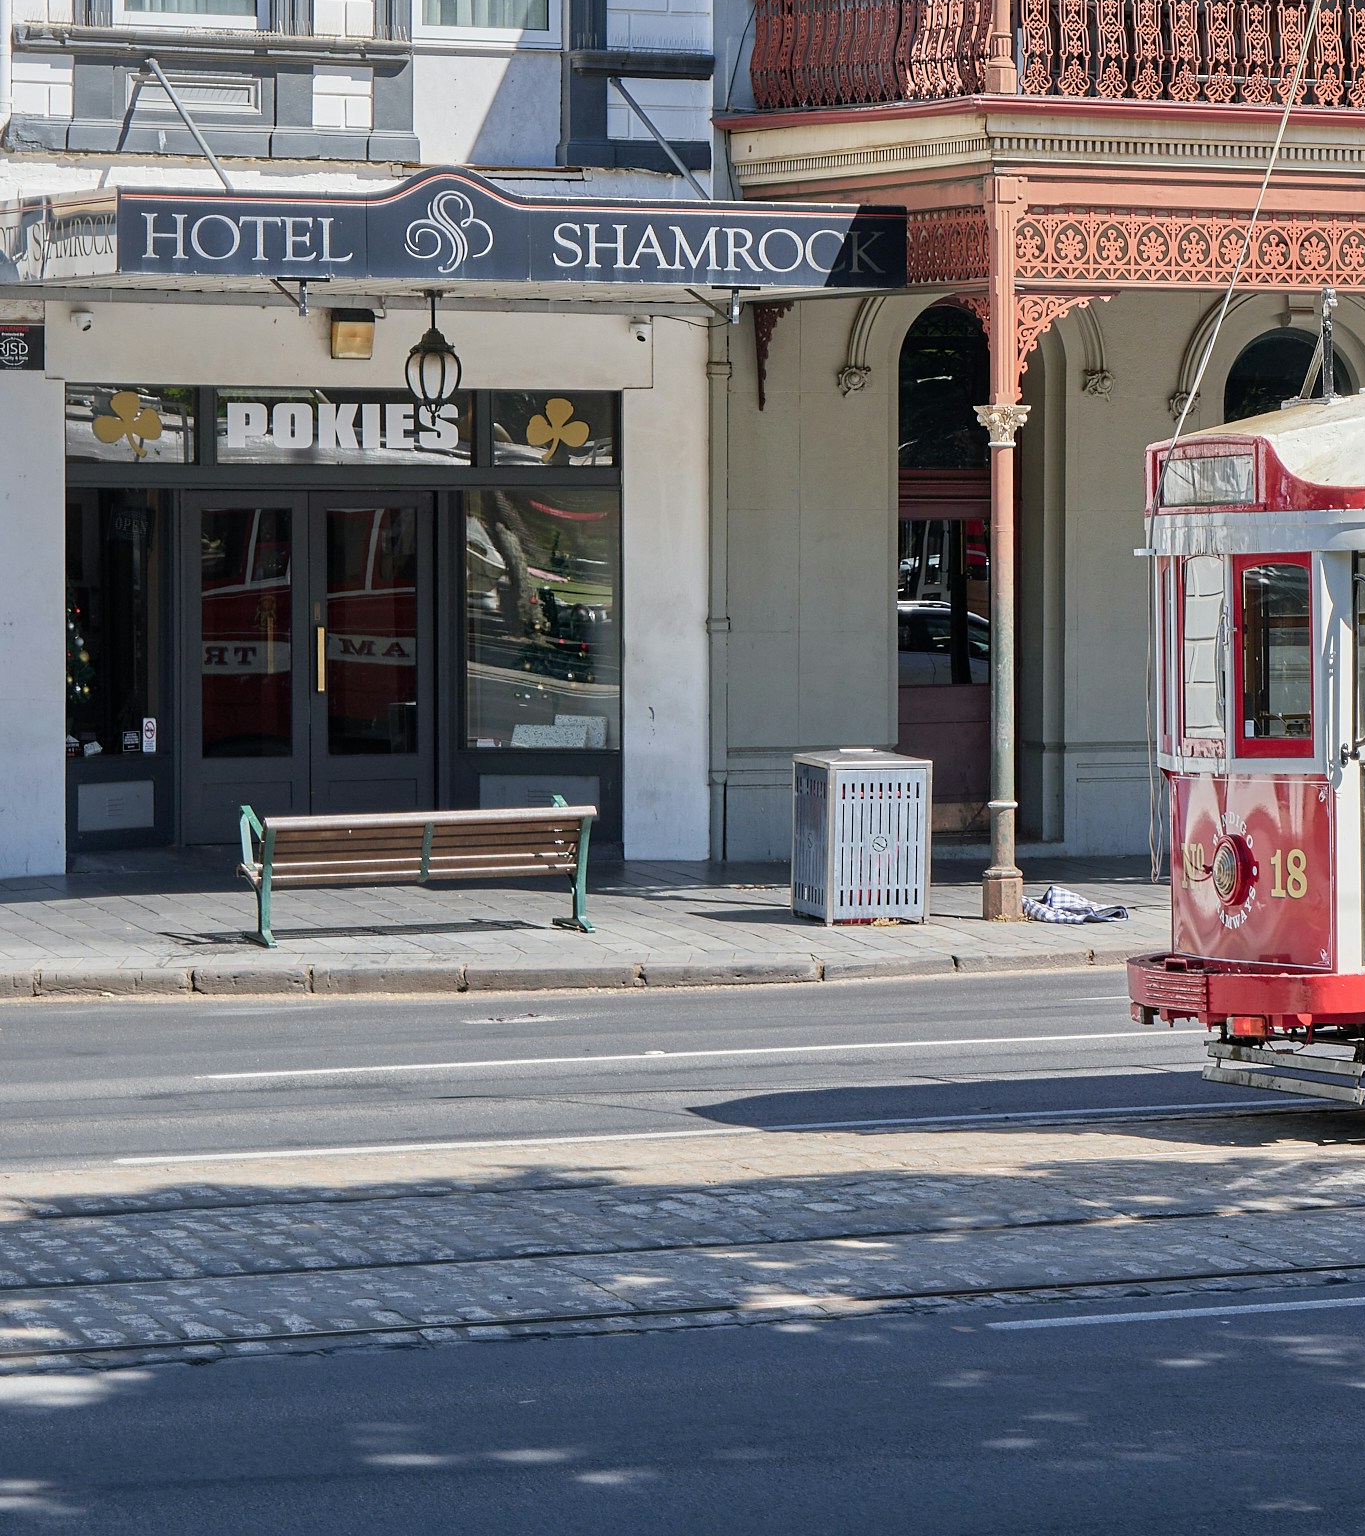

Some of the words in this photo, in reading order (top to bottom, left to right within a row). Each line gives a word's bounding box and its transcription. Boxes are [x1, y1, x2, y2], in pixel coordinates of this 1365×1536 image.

[141, 212, 353, 263] HOTEL
[552, 222, 887, 276] SHAMROCK
[0, 342, 29, 357] RJSD
[226, 402, 460, 451] POKIES
[1270, 848, 1308, 899] 18
